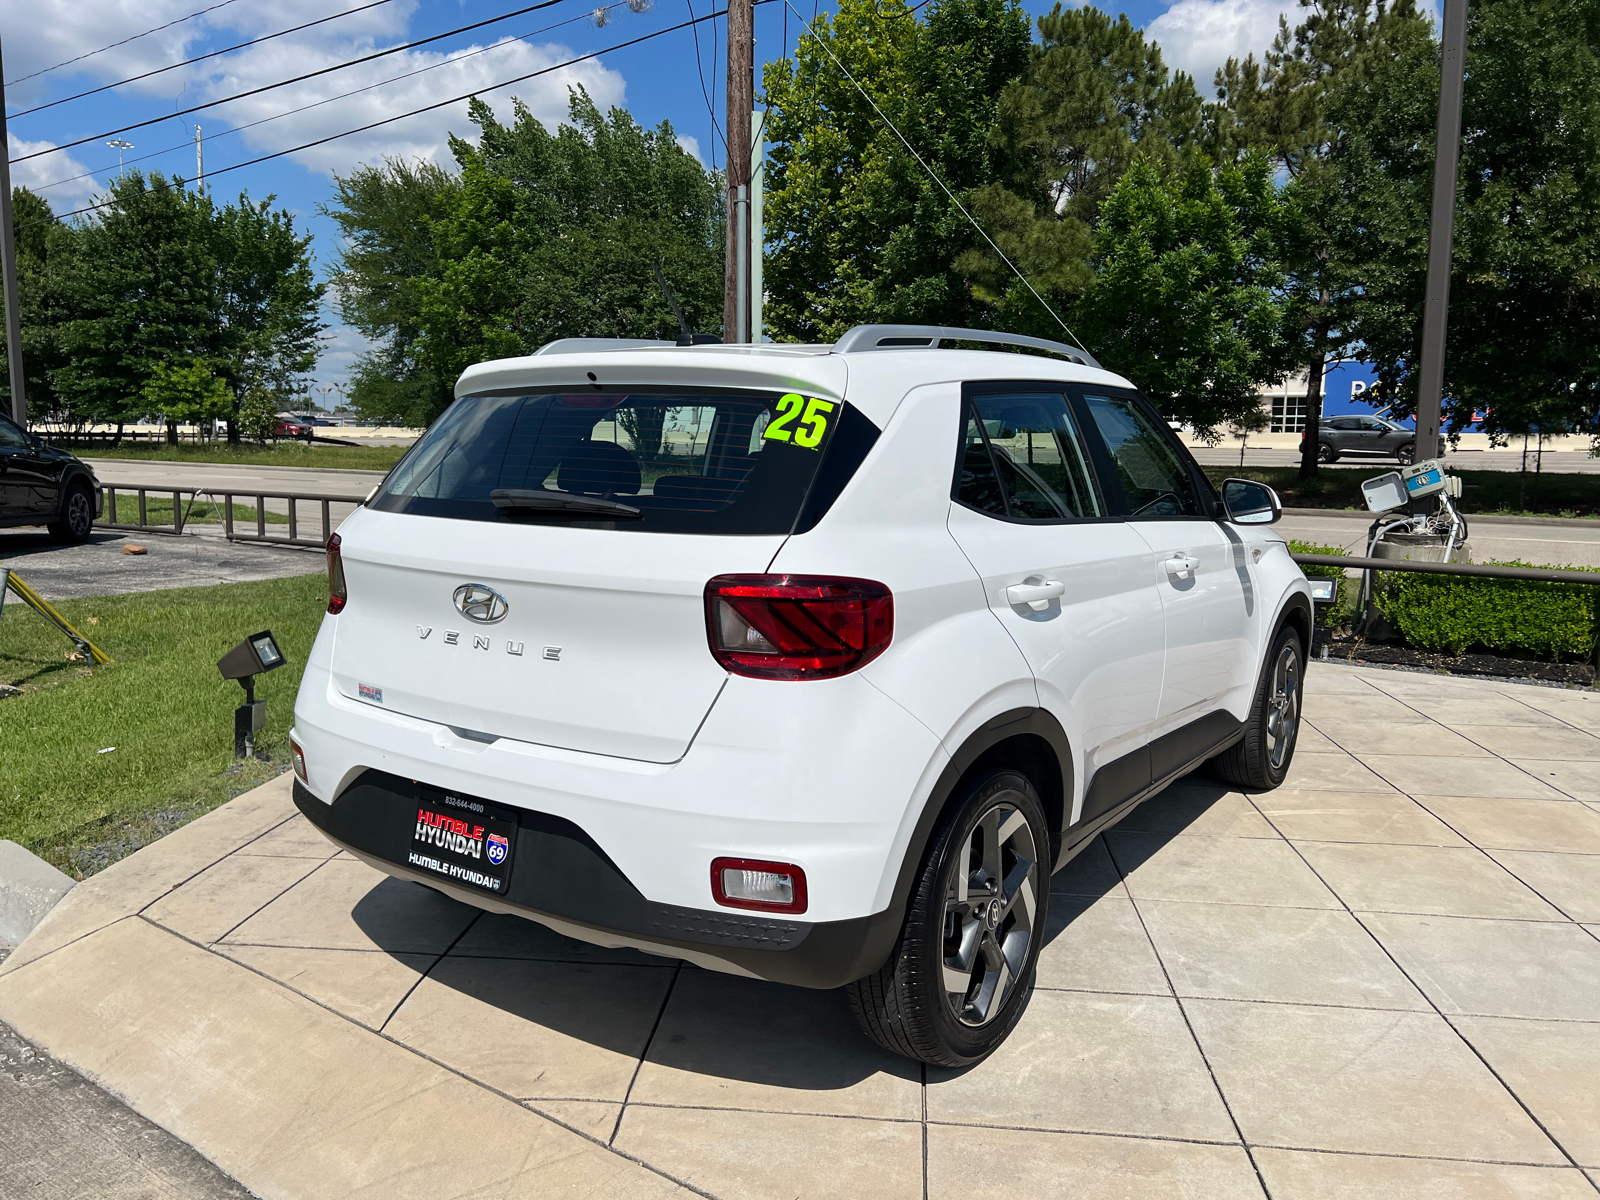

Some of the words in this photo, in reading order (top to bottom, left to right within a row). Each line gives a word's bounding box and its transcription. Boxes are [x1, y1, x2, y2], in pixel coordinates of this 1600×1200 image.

[763, 392, 835, 448] 25
[416, 624, 563, 661] VENUE
[445, 795, 484, 813] 832-644-4000
[414, 822, 483, 859] HYUNDAI
[417, 808, 485, 841] HUMBLE
[408, 852, 449, 874] HUMBLE
[449, 864, 493, 888] HYUNDAI
[489, 845, 505, 860] 69
